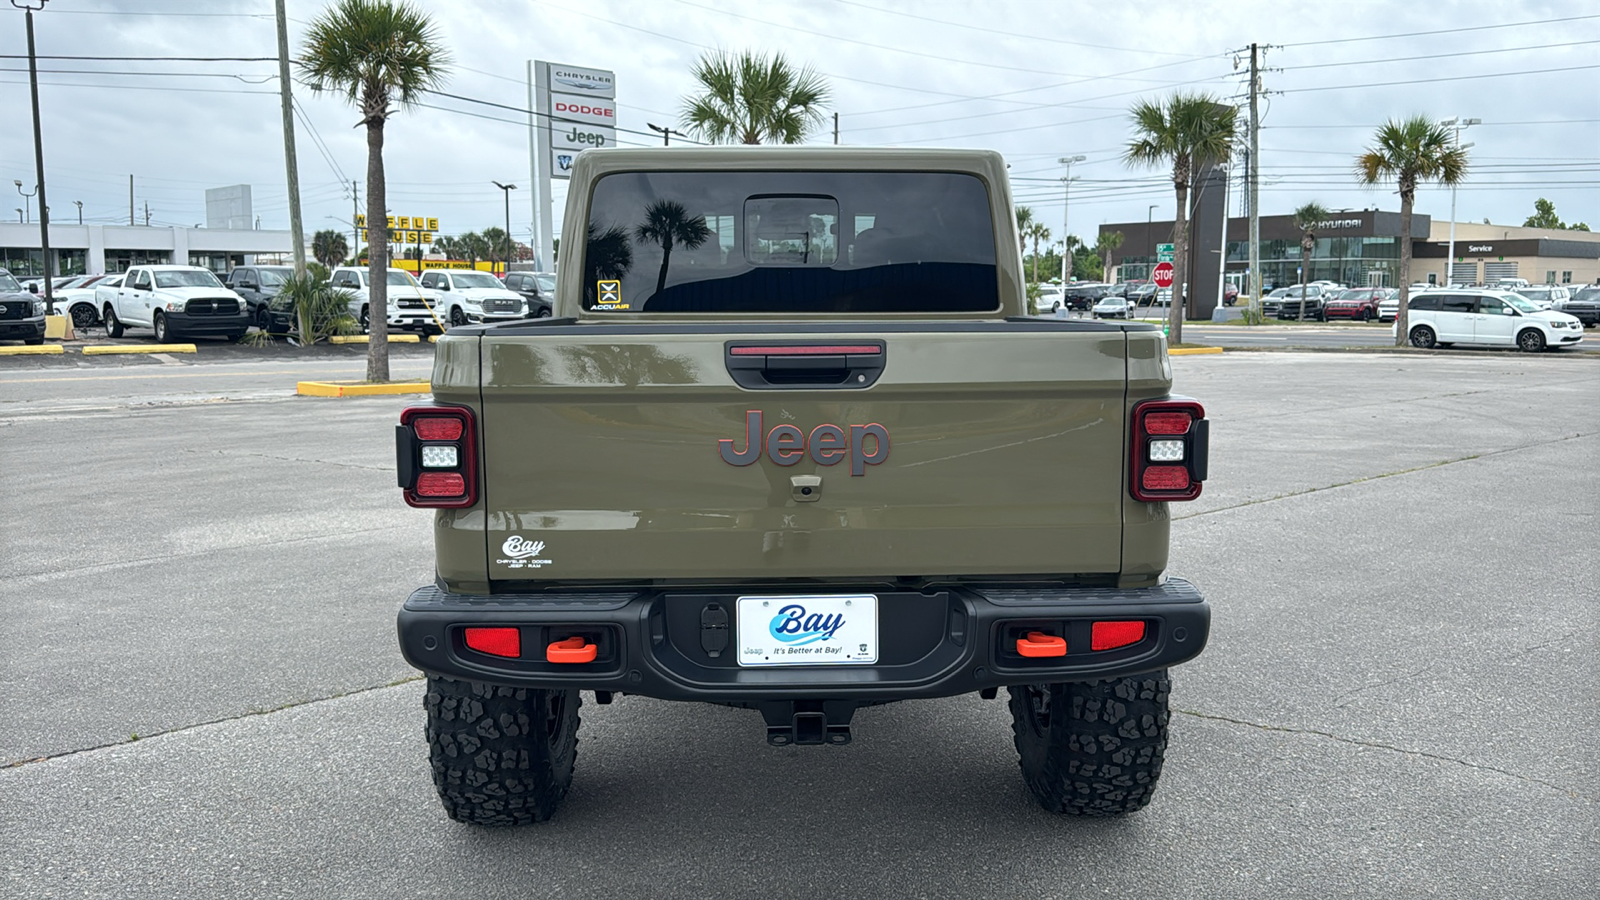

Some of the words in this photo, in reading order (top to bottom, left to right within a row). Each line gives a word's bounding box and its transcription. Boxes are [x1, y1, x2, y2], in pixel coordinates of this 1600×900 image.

[555, 71, 611, 83] CHRYSLER
[555, 102, 613, 117] DODGE
[566, 127, 605, 147] Jeep
[356, 215, 437, 229] WFFLE
[1318, 219, 1361, 229] HYUNDAI
[718, 410, 890, 476] Jeep
[502, 535, 546, 557] Bay
[773, 604, 846, 641] Bay
[773, 647, 785, 655] It's
[787, 647, 813, 655] Better
[825, 646, 842, 654] Bay!
